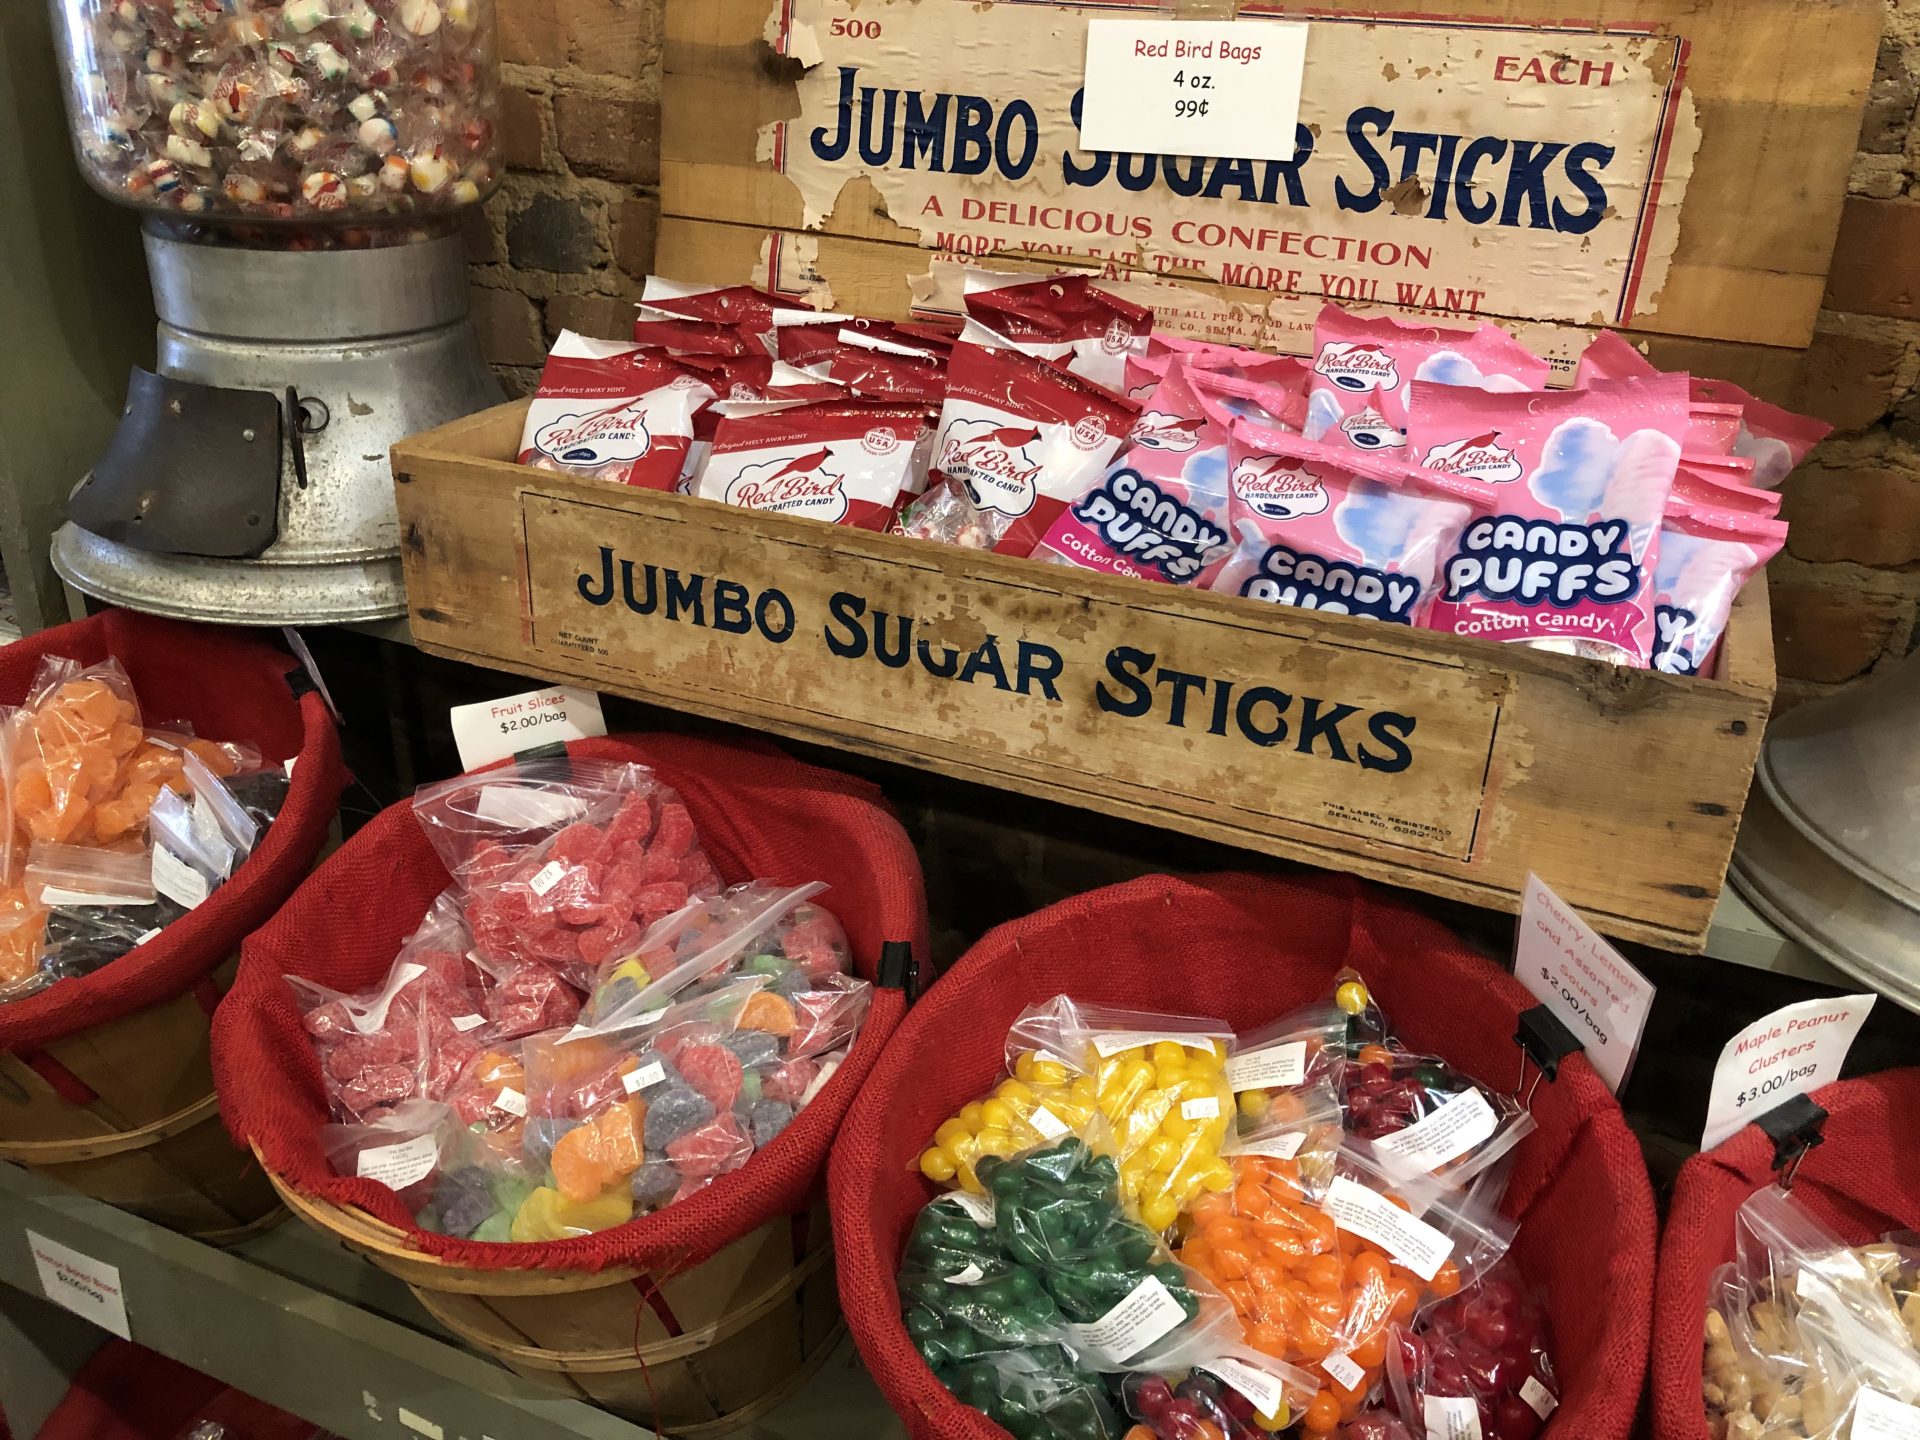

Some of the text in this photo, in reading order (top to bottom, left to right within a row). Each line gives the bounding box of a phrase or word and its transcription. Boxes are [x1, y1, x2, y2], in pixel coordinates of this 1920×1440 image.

[830, 18, 882, 40] 500
[1135, 40, 1261, 65] Red Bird Bags
[1173, 70, 1216, 90] 4 oz.
[1493, 55, 1614, 87] EACH
[1175, 99, 1209, 118] 99¢
[810, 67, 1038, 180] JUMBO
[1335, 106, 1615, 234] STICKS
[921, 195, 1433, 269] A DELICIOUS CONFECTION
[935, 232, 1006, 264] MORE
[1153, 254, 1206, 276] THE
[1221, 263, 1303, 300] MORE
[1320, 273, 1379, 304] YOU
[1396, 282, 1486, 320] WANT
[1147, 305, 1179, 317] WITH
[1185, 311, 1206, 320] ALL
[1213, 312, 1244, 322] PURE
[1107, 335, 1122, 345] USA
[1319, 353, 1396, 372] Red Bird
[964, 387, 982, 397] MELT
[983, 393, 1004, 404] AWAY
[1006, 401, 1025, 410] MINT
[543, 409, 648, 446] Red Bird
[869, 437, 888, 447] USA
[1077, 428, 1096, 441] USA
[939, 439, 1044, 486] Red Bird
[1428, 448, 1515, 472] Red Bird
[737, 474, 845, 508] Red Bird
[996, 480, 1025, 495] CANDY
[1238, 473, 1323, 493] Red Bird
[1245, 492, 1294, 500] HANDCRAFTED
[757, 497, 835, 511] NDCRAFTED CANDY
[1112, 474, 1221, 554] CANDY
[1061, 532, 1114, 565] Cotton
[1079, 495, 1201, 576] PUFFS
[1467, 521, 1620, 557] CANDY
[1267, 551, 1414, 613] CANDY
[1449, 556, 1632, 600] PUFFS
[1454, 612, 1610, 636] Cotton Candy
[577, 546, 1417, 774] JUMBO SUGAR STICKS
[491, 693, 566, 719] Fruit Slices
[500, 710, 567, 735] $2.00/bag
[1322, 801, 1345, 811] THIS
[1350, 808, 1382, 820] LABEL
[1328, 810, 1364, 823] SERIAL
[1536, 919, 1630, 1014] and Assorted
[1559, 963, 1598, 1007] Sours
[1540, 967, 1608, 1045] $2.00/bag
[1735, 1011, 1850, 1057] Maple Peanut
[1748, 1039, 1816, 1075] Clusters
[1736, 1063, 1817, 1108] $3.00/bag
